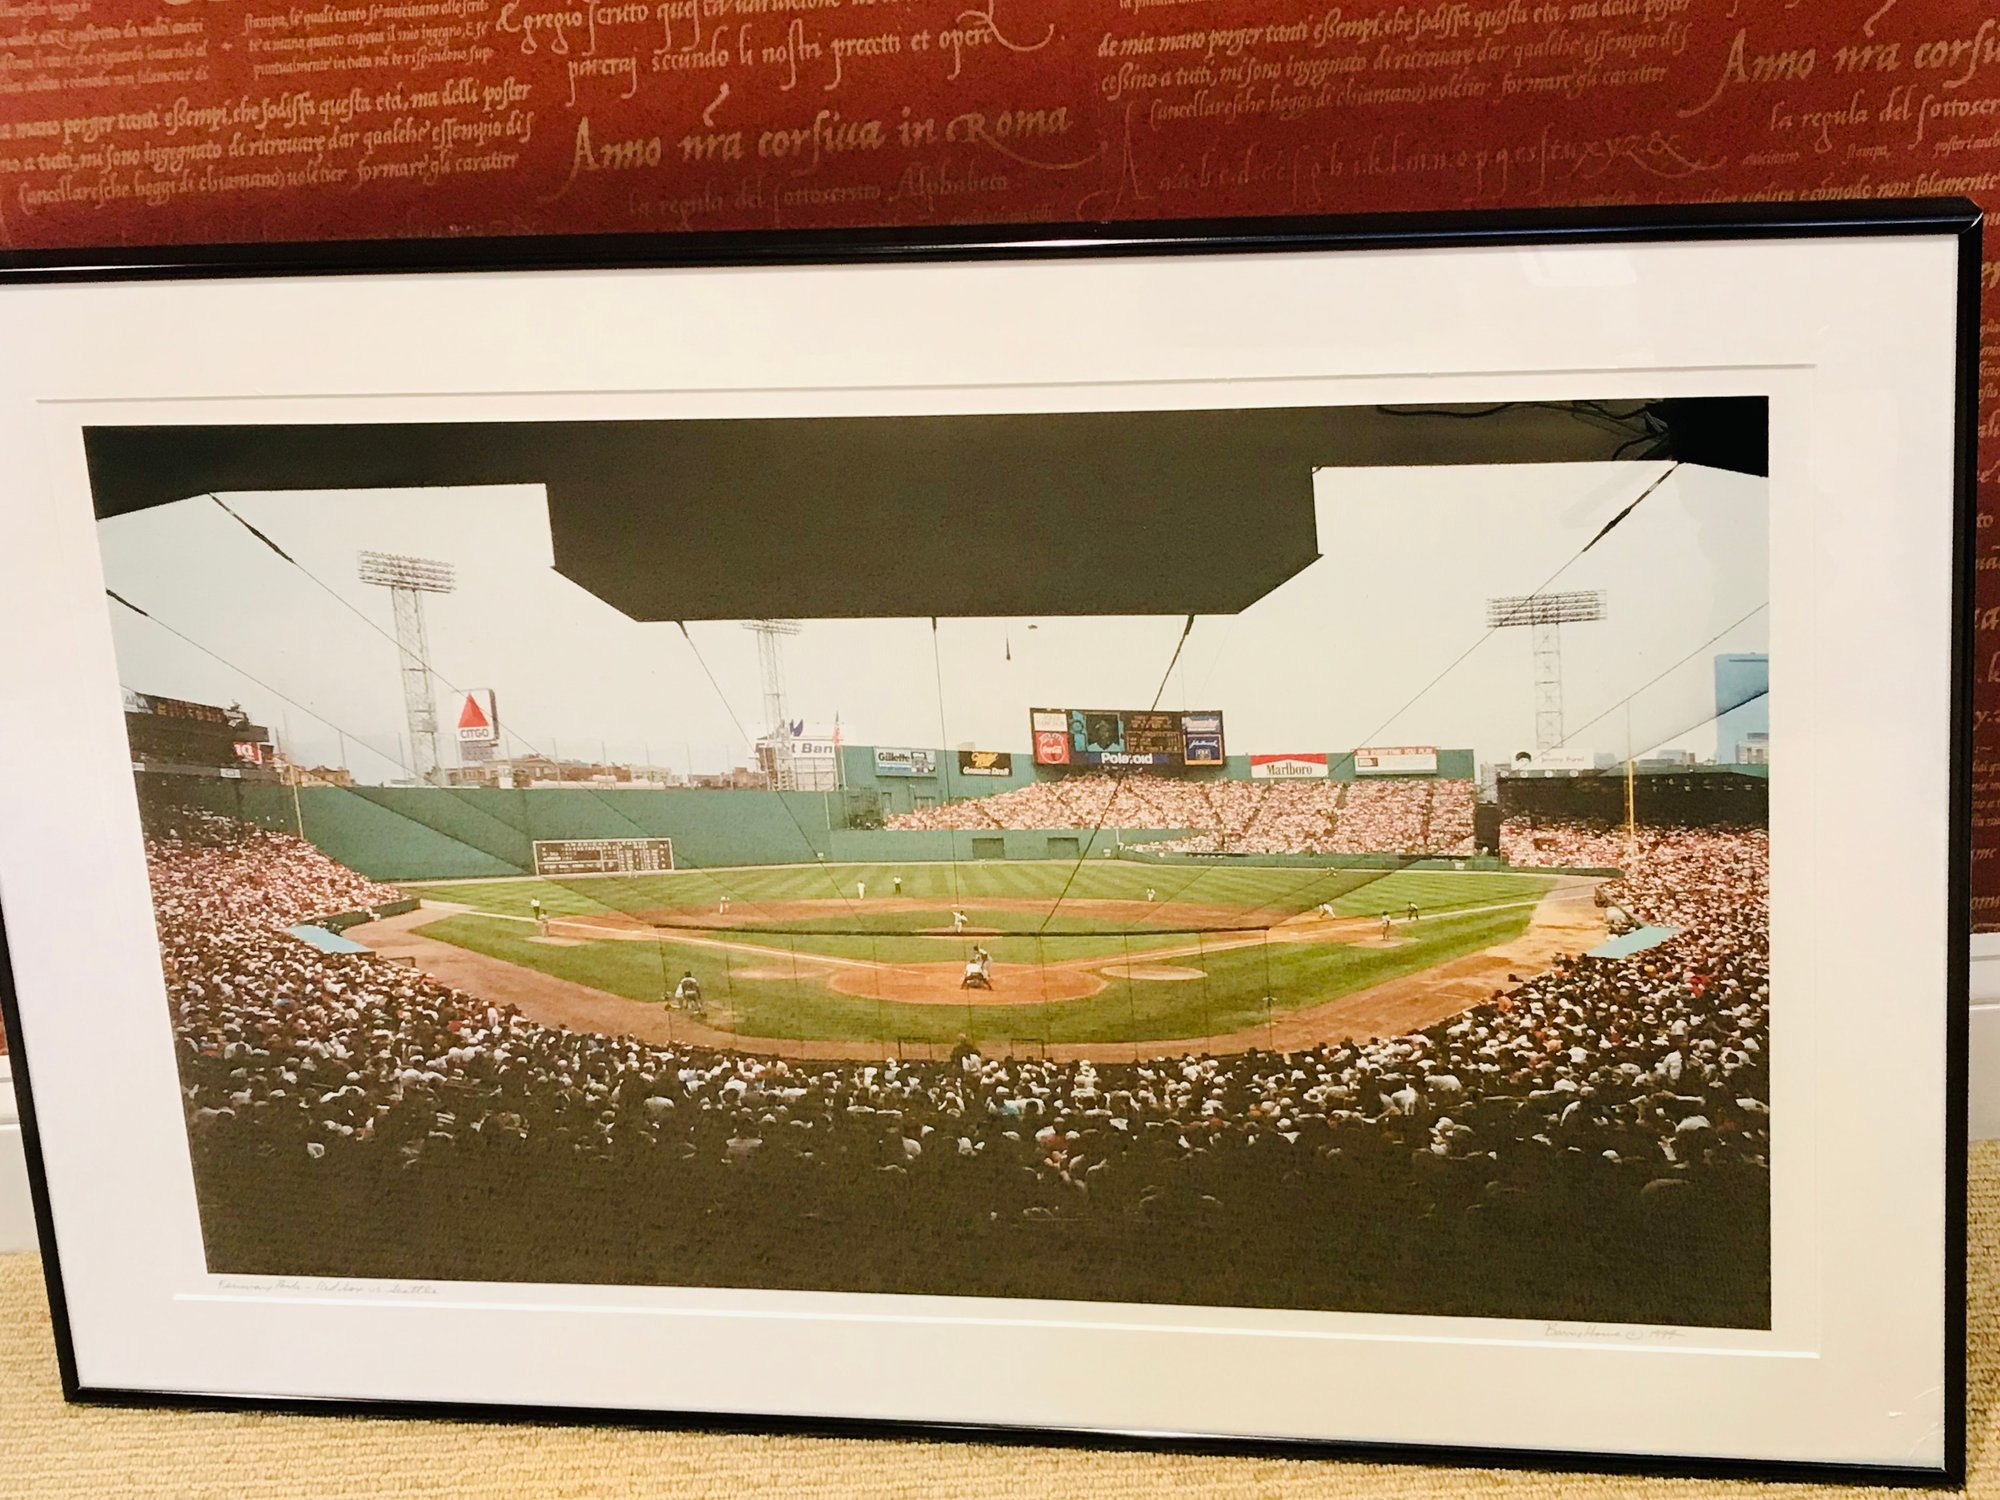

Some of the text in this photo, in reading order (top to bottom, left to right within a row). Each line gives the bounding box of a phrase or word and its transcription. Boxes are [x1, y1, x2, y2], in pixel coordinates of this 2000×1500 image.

[899, 105, 938, 148] in
[460, 728, 490, 740] CITGO
[802, 743, 834, 754] Ban
[878, 752, 910, 763] Gillette
[1266, 761, 1312, 776] Marlboro
